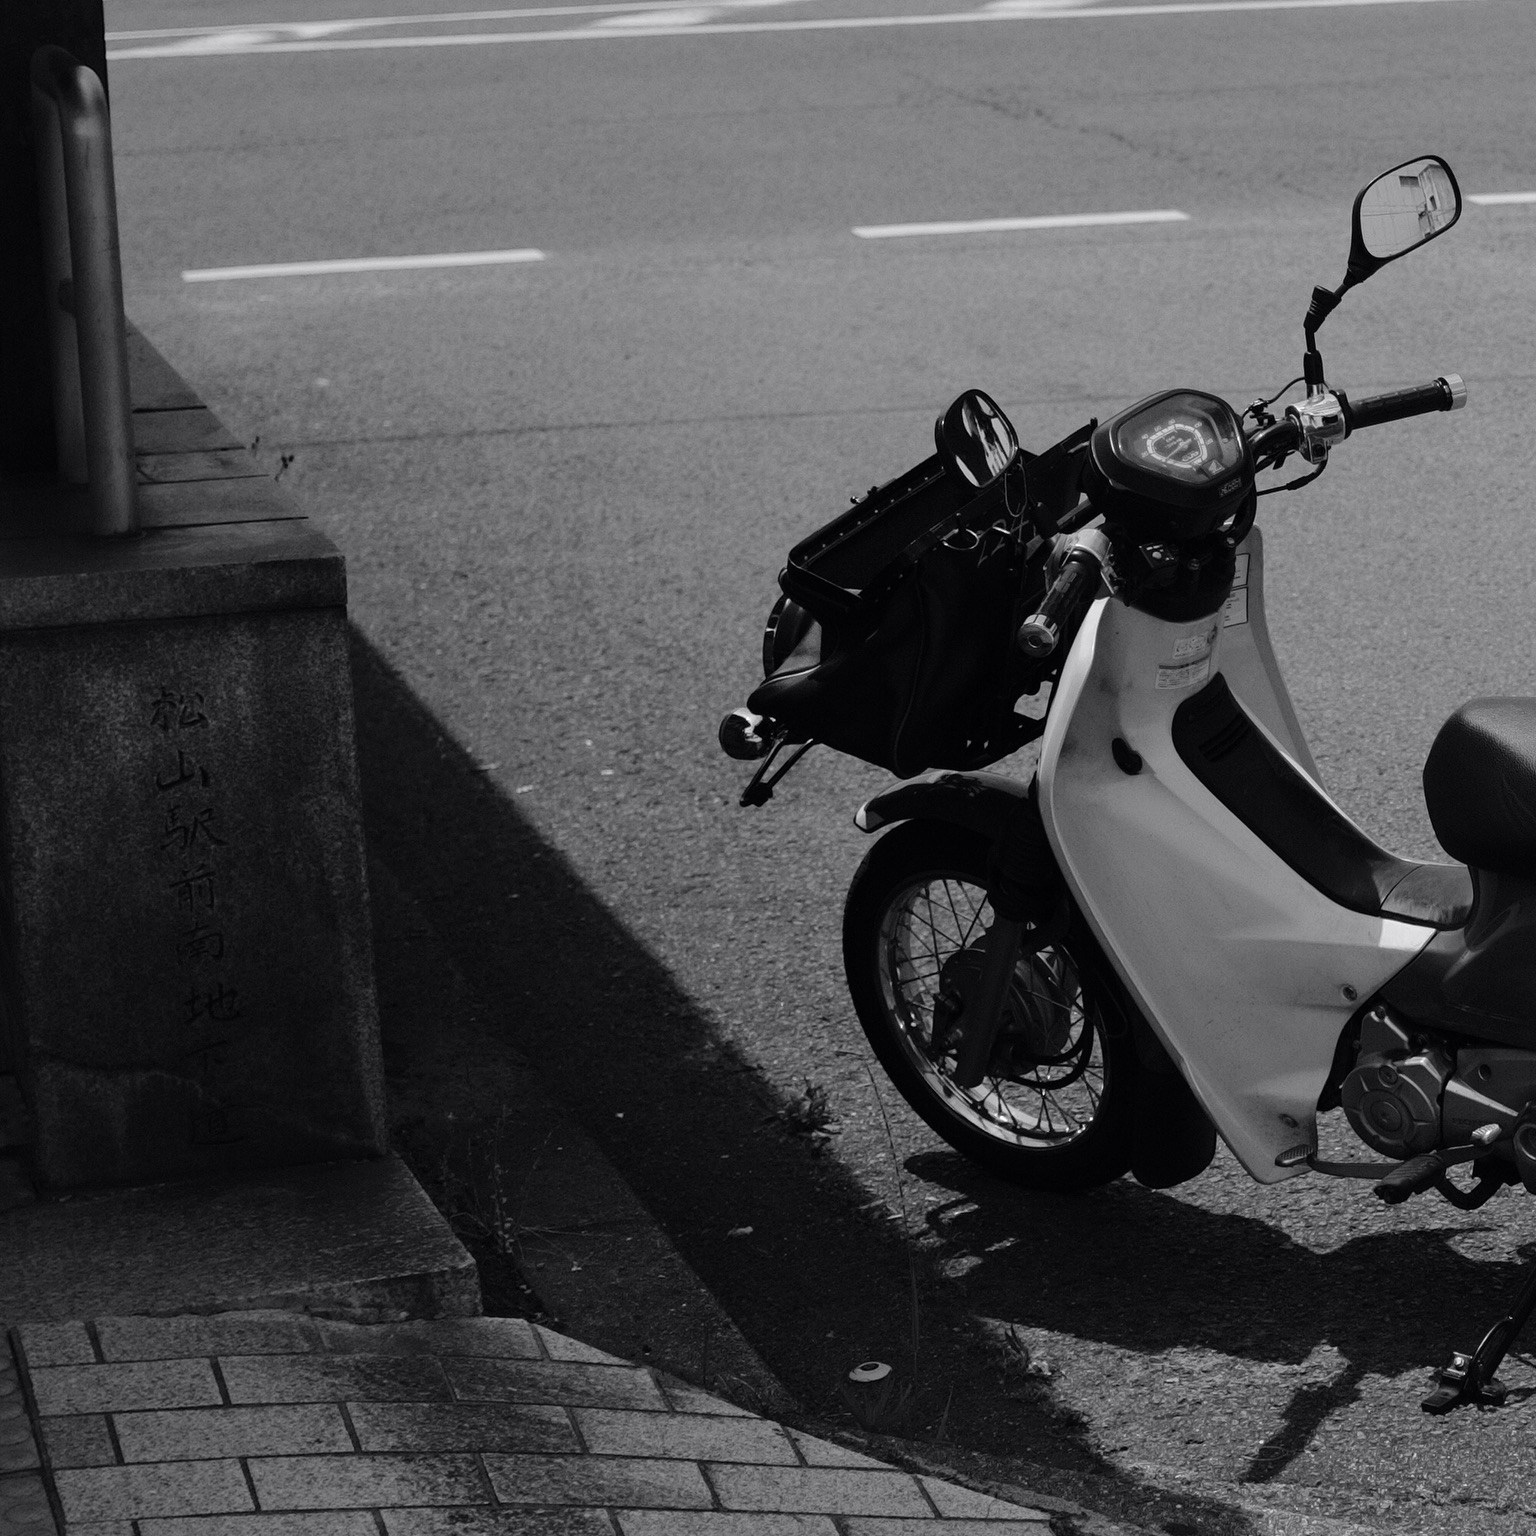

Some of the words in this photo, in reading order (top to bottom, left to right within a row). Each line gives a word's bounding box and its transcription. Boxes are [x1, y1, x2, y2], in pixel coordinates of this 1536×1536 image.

[149, 685, 248, 1147] 松山駅前南地下道
